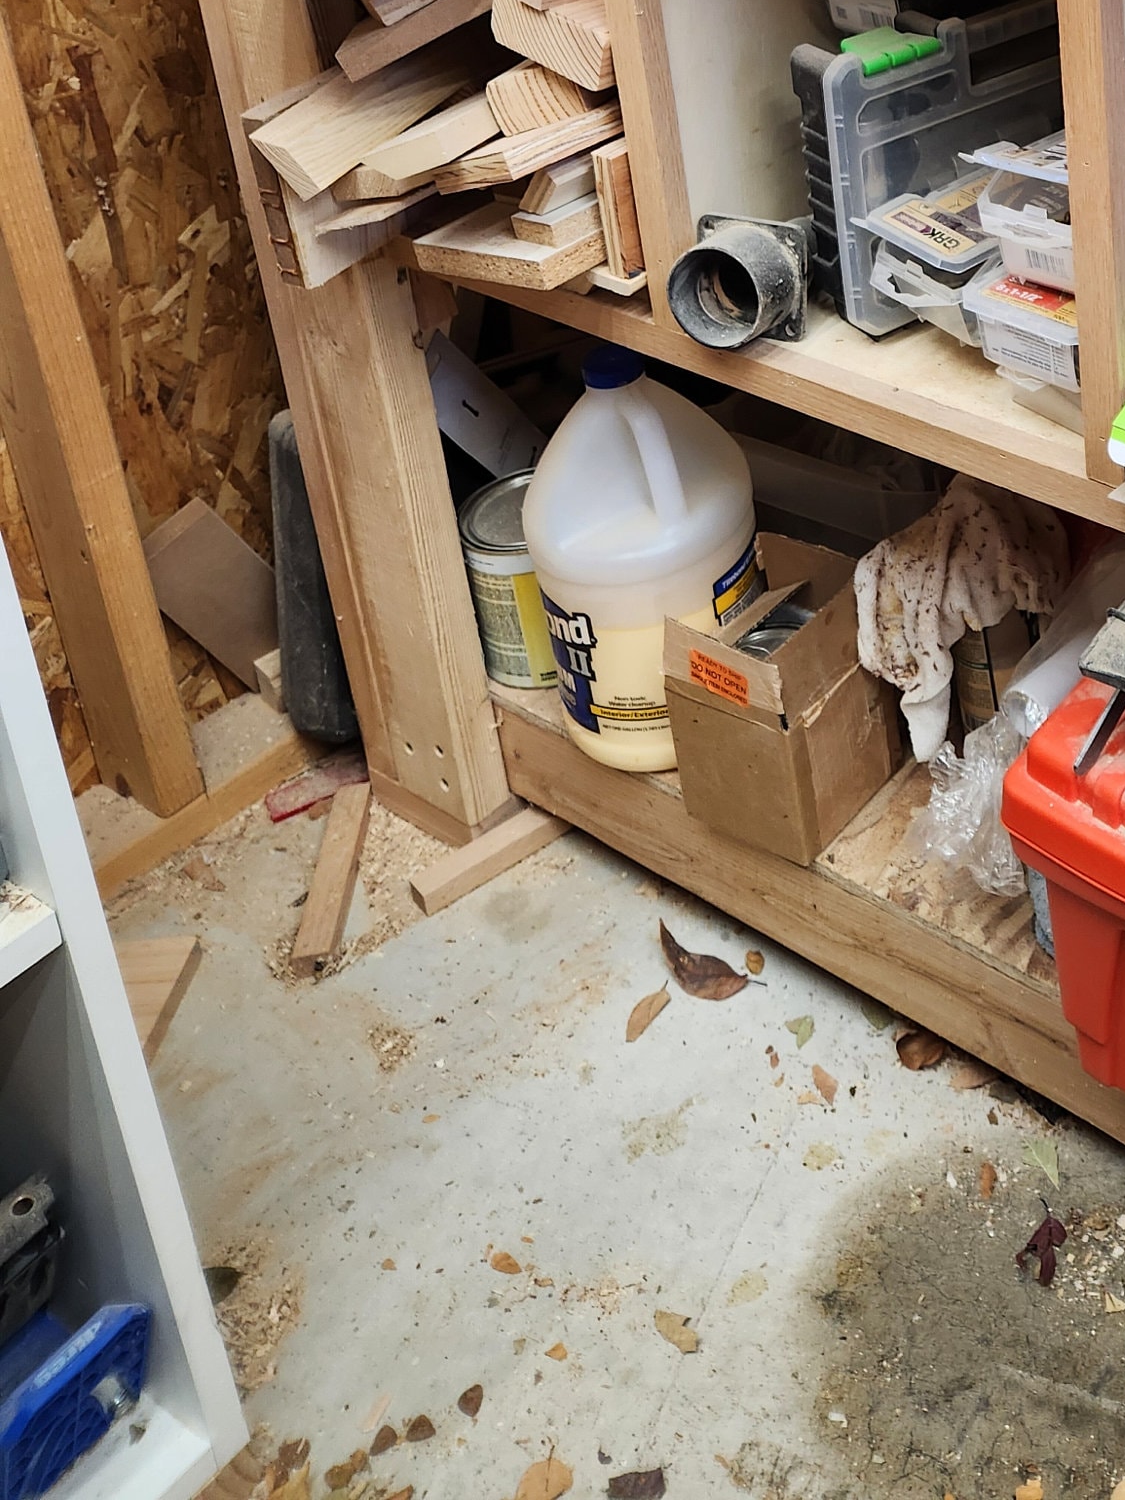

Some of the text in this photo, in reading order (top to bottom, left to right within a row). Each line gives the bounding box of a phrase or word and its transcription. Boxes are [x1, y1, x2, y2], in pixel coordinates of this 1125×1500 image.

[928, 227, 960, 250] GRK
[567, 649, 592, 676] II
[691, 660, 747, 695] DO NOT OPEN
